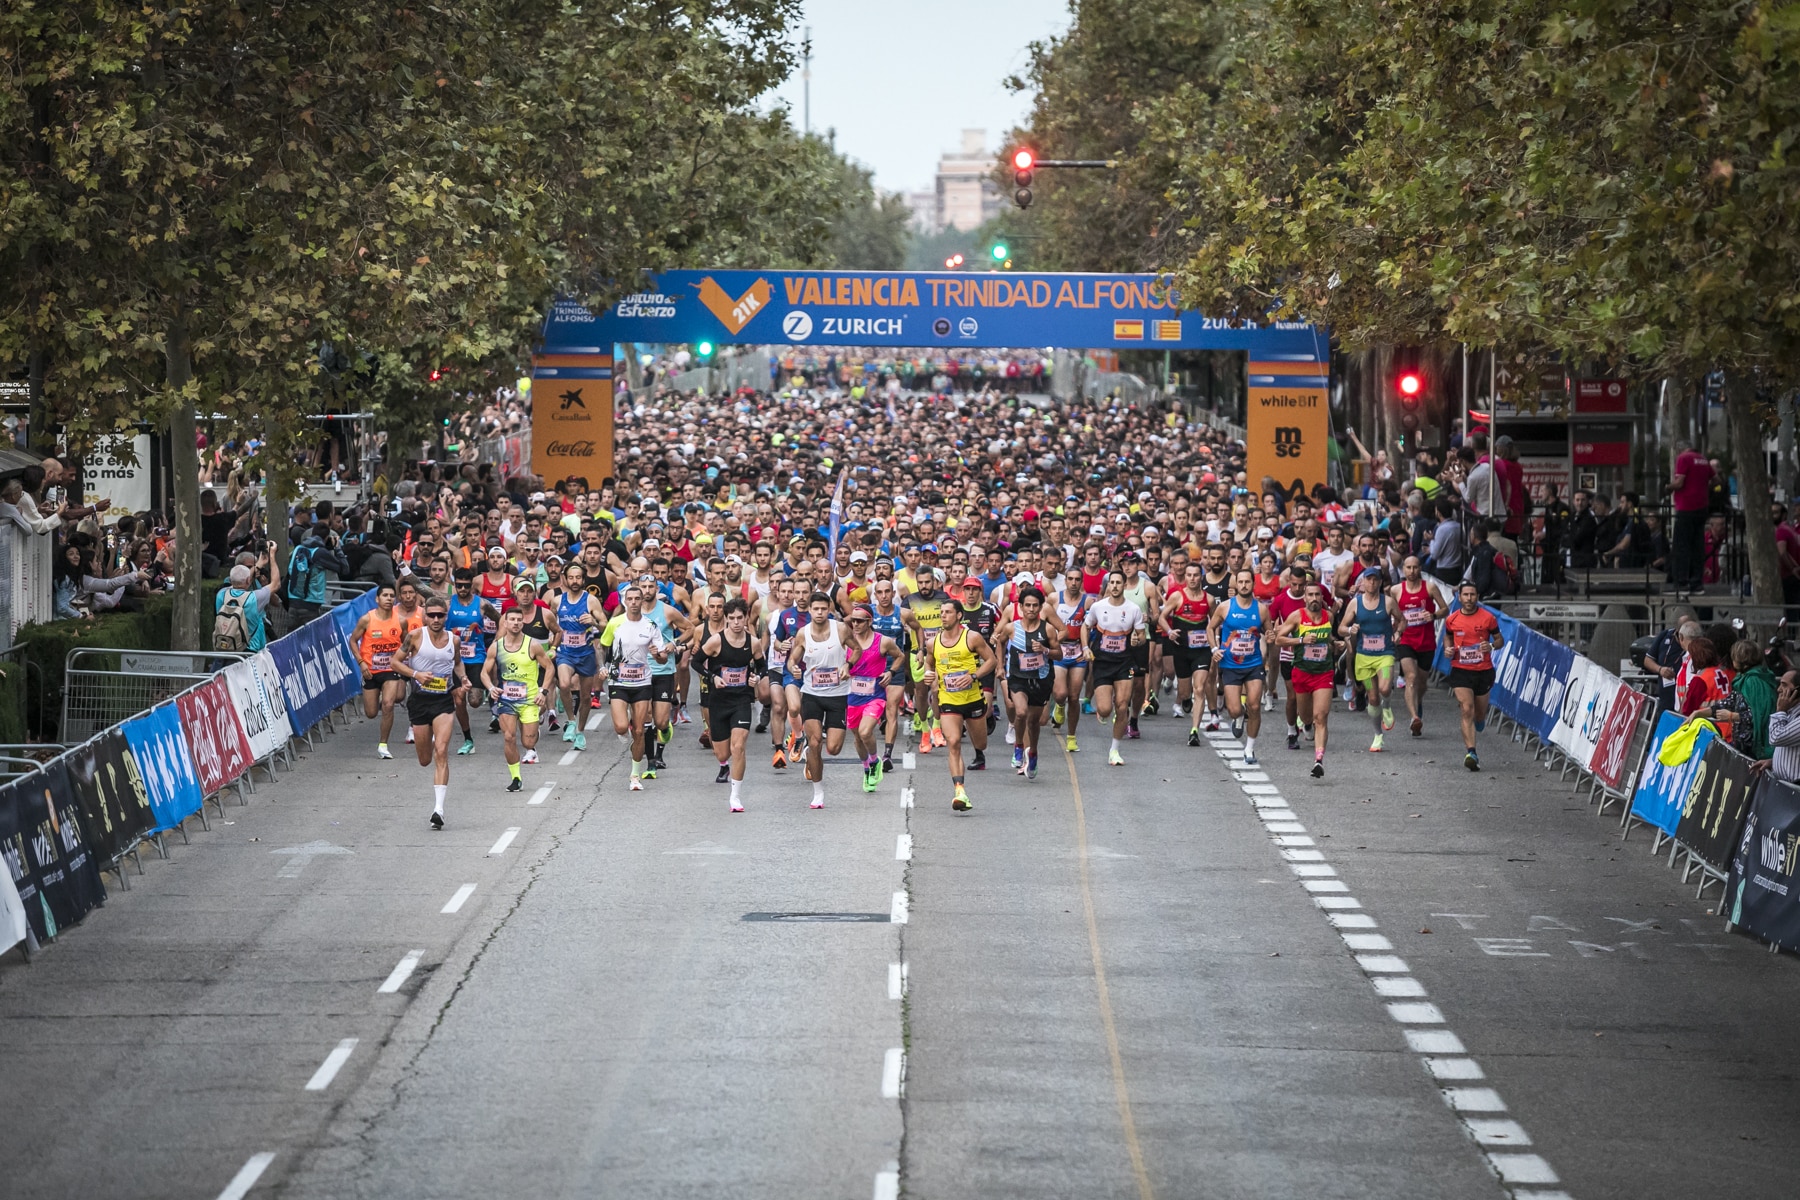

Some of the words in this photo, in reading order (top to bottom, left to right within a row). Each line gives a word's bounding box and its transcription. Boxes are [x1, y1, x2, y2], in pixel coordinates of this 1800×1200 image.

[784, 277, 920, 306] VALENCIA
[925, 279, 1051, 308] TRINIDAD
[617, 304, 676, 317] Esfuerzo
[732, 292, 761, 325] 21K
[822, 318, 902, 335] ZURICH
[101, 466, 135, 479] más
